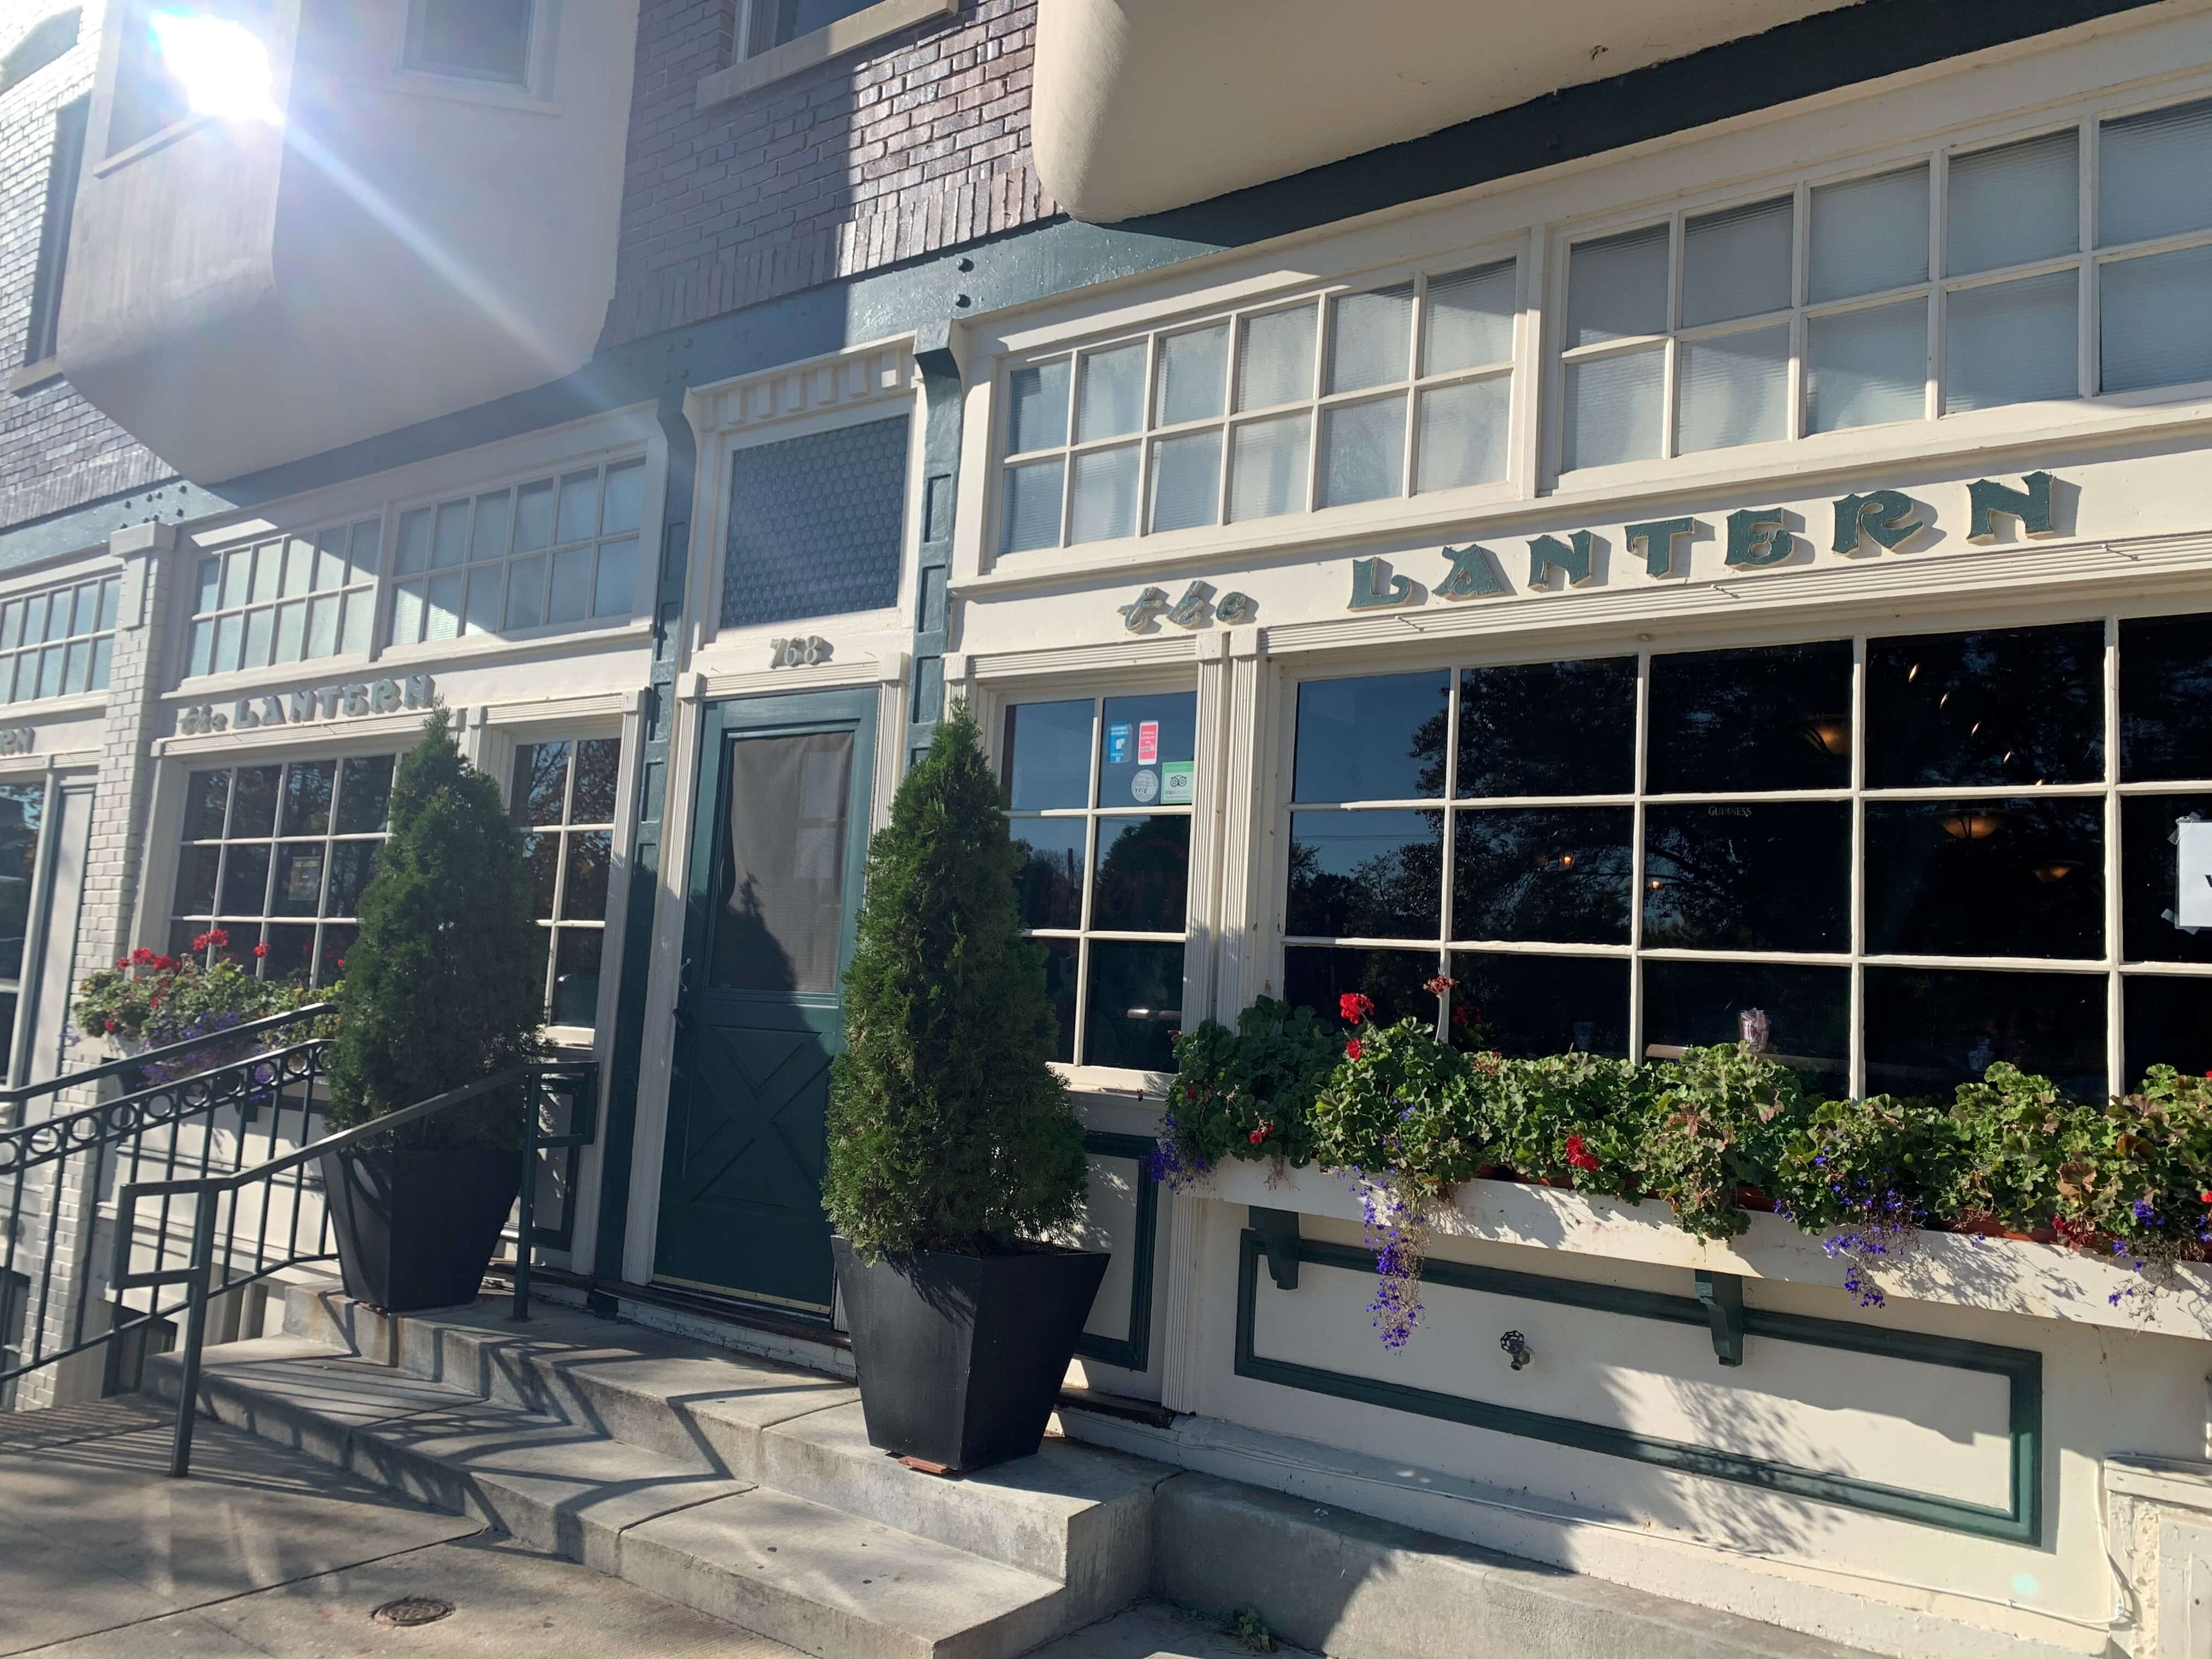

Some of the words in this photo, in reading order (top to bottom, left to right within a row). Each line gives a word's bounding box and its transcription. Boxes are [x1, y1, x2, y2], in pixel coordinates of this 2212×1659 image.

[1118, 580, 1248, 634] the
[1347, 470, 2055, 612] LANTERN
[768, 636, 820, 668] 768
[179, 703, 227, 735] the
[233, 674, 435, 729] LANTERN
[1708, 806, 1752, 816] GUINNESS
